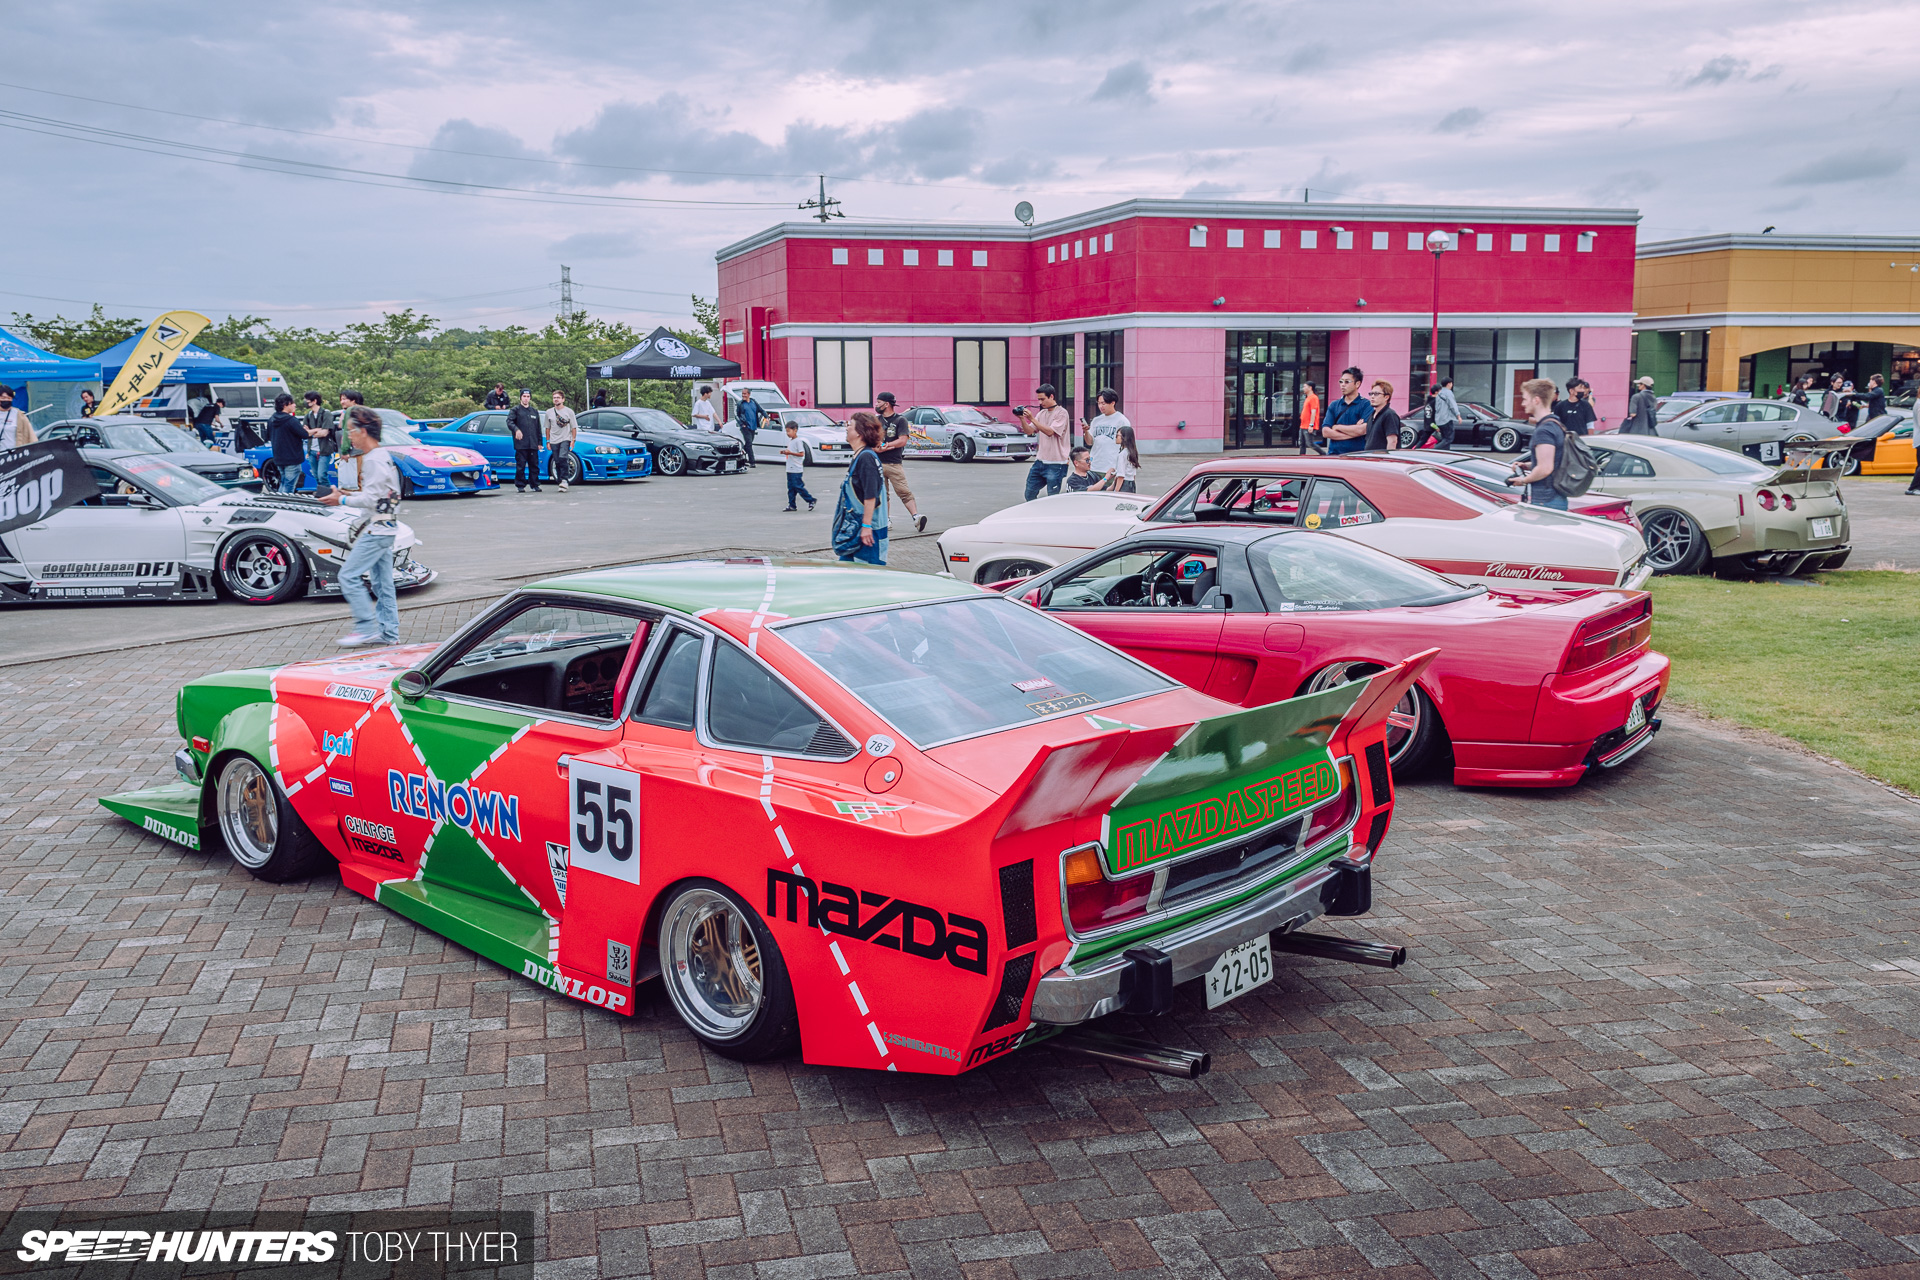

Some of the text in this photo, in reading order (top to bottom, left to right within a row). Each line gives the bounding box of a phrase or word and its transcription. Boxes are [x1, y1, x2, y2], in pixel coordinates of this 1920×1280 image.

[42, 562, 135, 573] dogfight japan
[135, 562, 174, 576] DFJ
[1485, 562, 1564, 581] Plump Diner
[46, 587, 124, 596] FUN RIDE SHARING
[335, 685, 376, 702] IDEMITSU
[869, 740, 889, 753] 787
[388, 768, 522, 843] RENOWN
[1117, 760, 1335, 872] MAZDASPEED
[143, 815, 199, 849] DUNLOP
[345, 815, 397, 844] CHARGE
[577, 778, 633, 862] 55
[609, 945, 628, 971] 影
[608, 971, 629, 984] Shadow
[1210, 945, 1269, 998] す 22-05
[521, 959, 627, 1011] DUNLOP
[891, 1034, 953, 1060] SHIBATA
